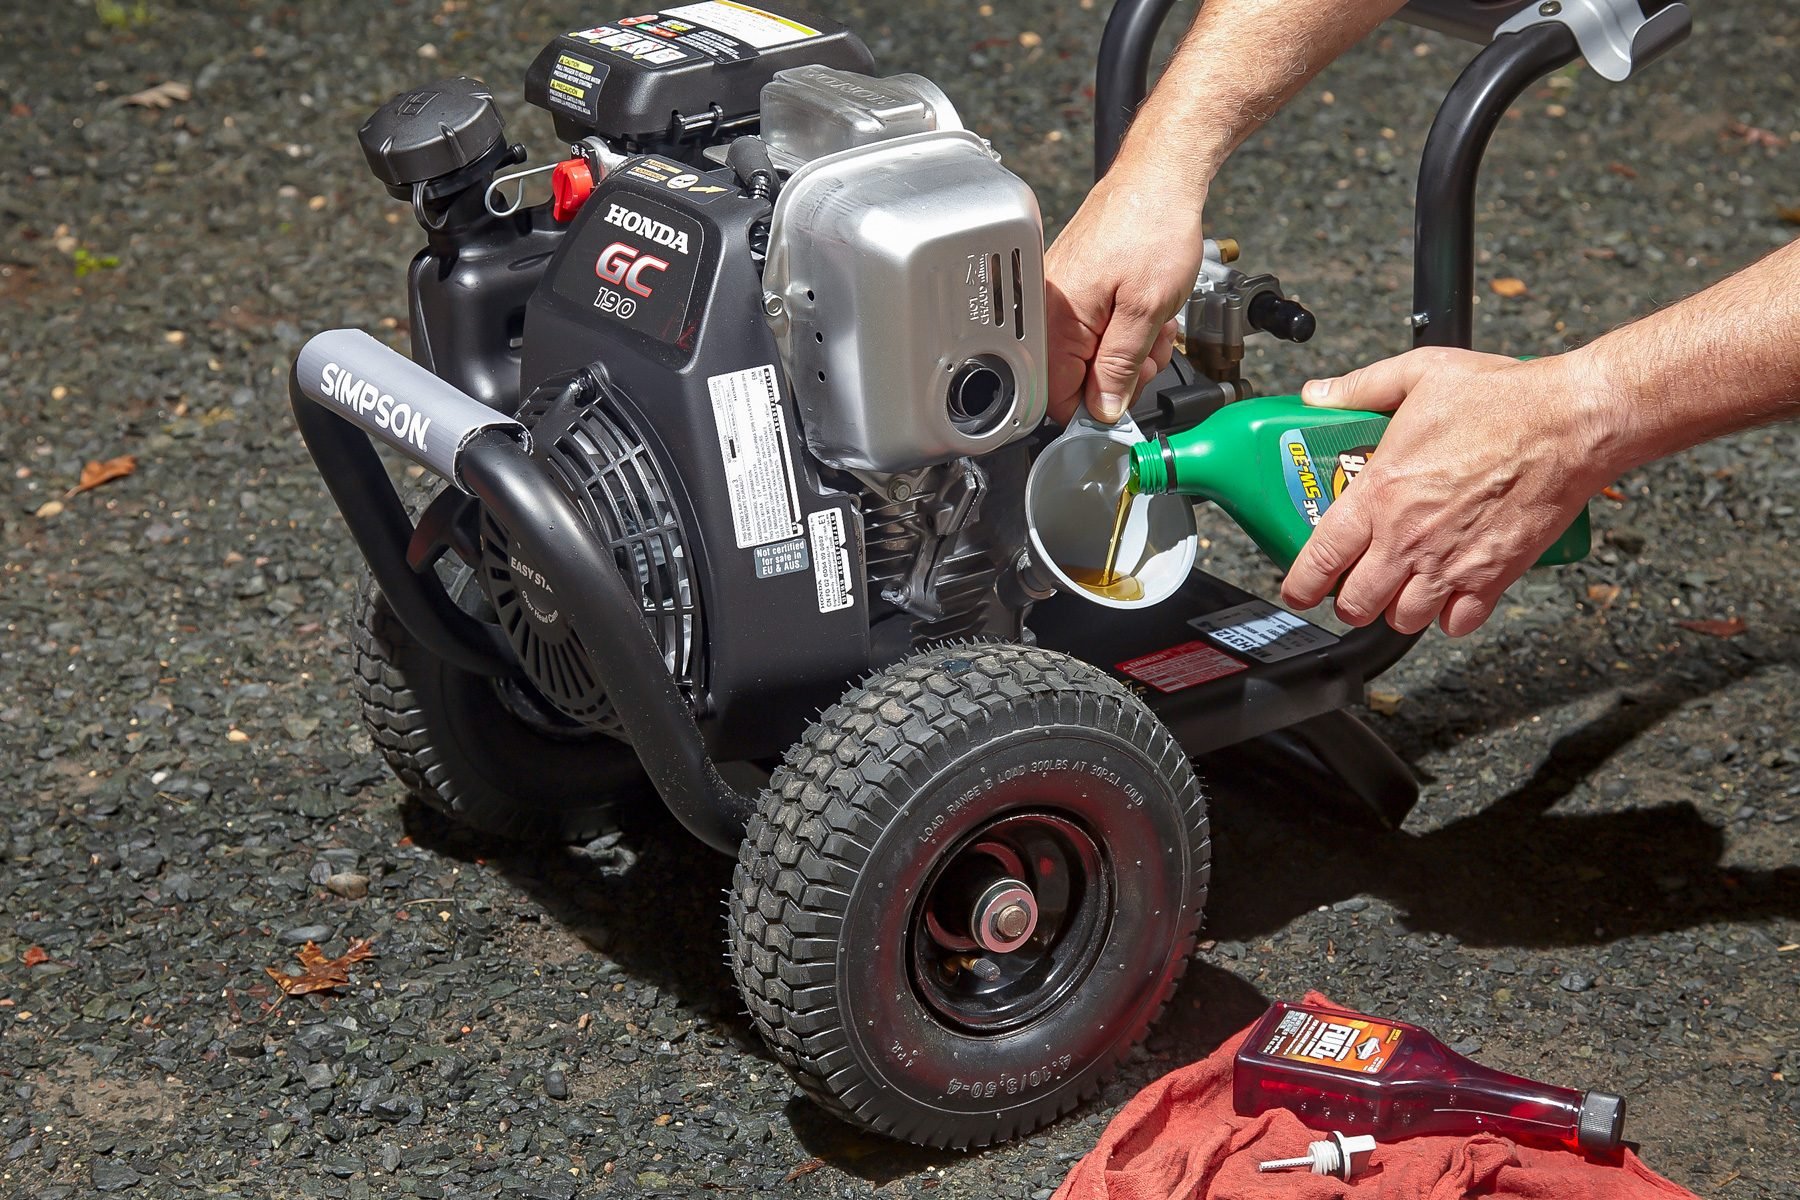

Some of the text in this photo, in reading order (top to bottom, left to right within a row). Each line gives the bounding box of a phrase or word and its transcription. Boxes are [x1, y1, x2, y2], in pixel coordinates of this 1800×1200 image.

[604, 204, 689, 254] HONDA
[595, 241, 670, 298] GC
[593, 286, 637, 320] 190
[968, 297, 979, 320] HOT
[320, 362, 431, 451] SIMPSON
[1288, 442, 1323, 526] SAE 5W-30
[817, 514, 825, 525] E1
[756, 540, 804, 558] Not certified
[761, 549, 801, 566] for sale in
[510, 556, 534, 580] EASY
[762, 559, 802, 575] EU & AUS.
[521, 590, 534, 611] Over
[534, 609, 548, 624] Head
[817, 579, 825, 609] HONDA
[1130, 654, 1167, 667] DANGER
[918, 814, 946, 844] LOAD
[946, 785, 982, 816] RANGE
[997, 765, 1026, 785] LOAD
[1031, 759, 1070, 774] 300LBS
[1072, 761, 1087, 771] AT
[1124, 783, 1145, 807] COLD
[1313, 1023, 1353, 1059] FUEL
